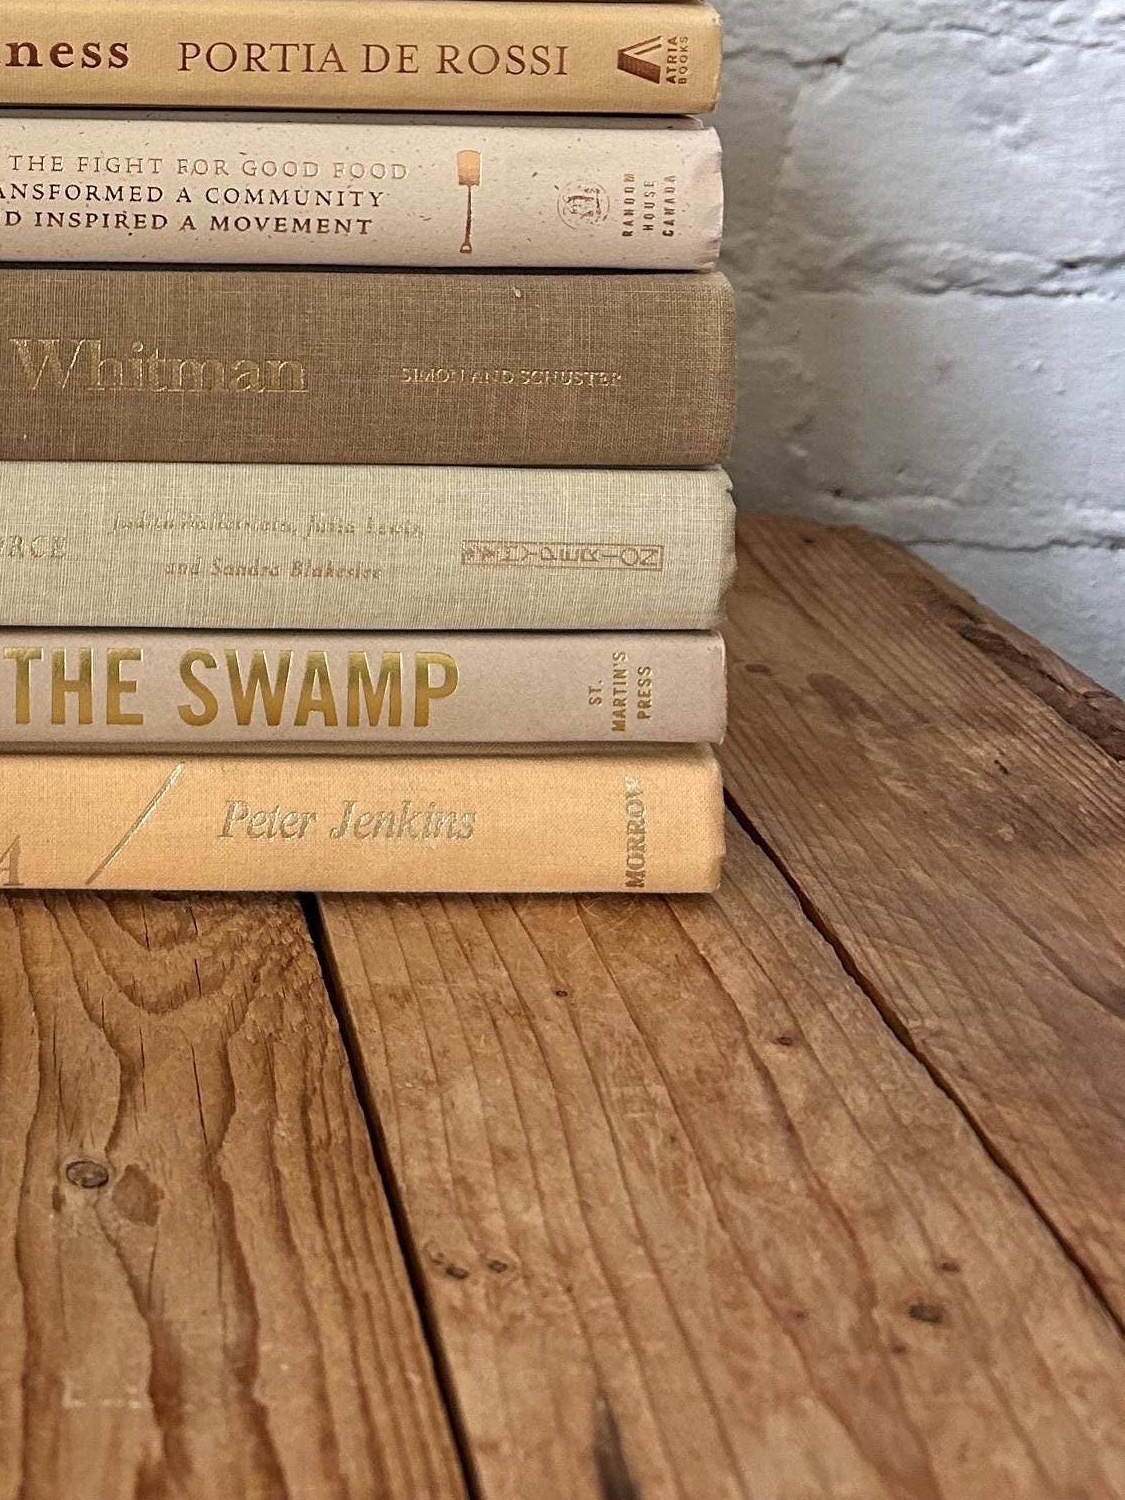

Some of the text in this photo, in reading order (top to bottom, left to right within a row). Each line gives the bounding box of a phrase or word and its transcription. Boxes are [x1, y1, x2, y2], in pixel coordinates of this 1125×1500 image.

[177, 41, 568, 76] PORTIA DE ROSSI
[665, 36, 677, 84] ATRIA
[678, 36, 689, 84] BOOKS
[9, 154, 63, 172] THE
[78, 156, 163, 176] FIGHT
[177, 158, 230, 176] FOR
[241, 160, 319, 178] GOOD
[333, 162, 409, 180] FOOD
[177, 186, 191, 203] A
[205, 186, 384, 207] COMMUNITY
[622, 173, 635, 237] RANDOM
[643, 179, 655, 231] HOUSE
[663, 174, 675, 237] CANADA
[35, 212, 168, 231] INSPIRED
[181, 215, 197, 231] A
[210, 215, 374, 236] MOVEMENT
[10, 335, 309, 394] Whitman
[470, 368, 515, 385] AND
[164, 558, 201, 576] and
[4, 647, 460, 728] THE SWAMP
[589, 680, 602, 705] ST.
[612, 651, 626, 731] MARTIN'S
[637, 666, 652, 719] PRESS
[218, 800, 477, 842] Peter Jenkins
